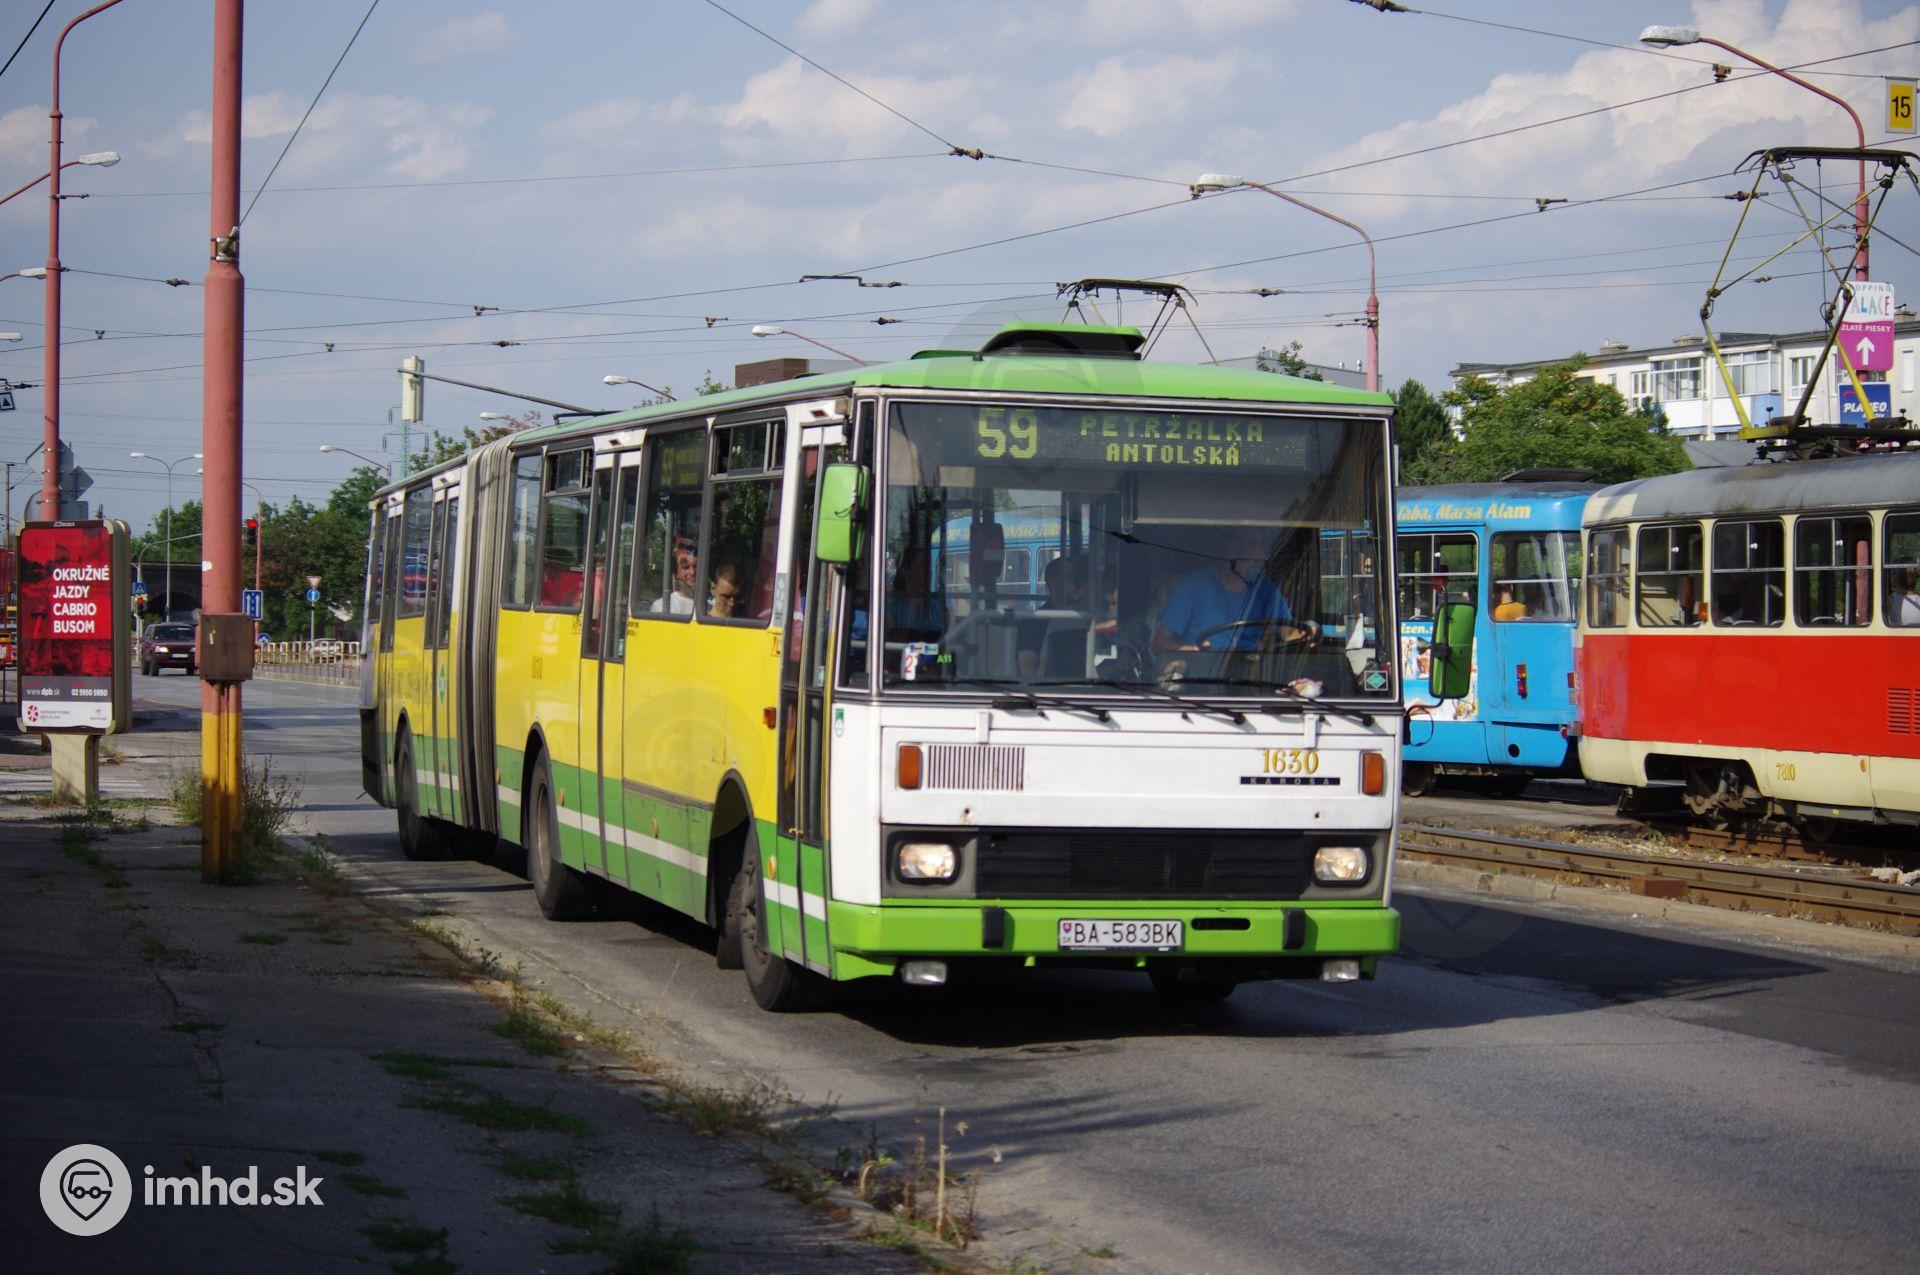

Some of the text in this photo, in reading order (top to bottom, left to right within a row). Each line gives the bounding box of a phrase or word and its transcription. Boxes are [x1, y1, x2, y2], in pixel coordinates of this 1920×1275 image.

[1891, 96, 1911, 118] 15
[1843, 295, 1890, 316] ALACE
[1843, 401, 1888, 413] PLAEO
[978, 407, 1038, 459] 59
[1080, 414, 1264, 442] PETRŽALKA
[1106, 441, 1240, 466] ANTOLSKÁ
[1435, 501, 1483, 520] Marsa
[1485, 501, 1531, 519] Alam
[52, 564, 110, 581] OKRUŽNÉ
[52, 585, 90, 599] JAZDY
[52, 602, 97, 616] CABRIO
[53, 620, 95, 633] BUSOM
[1263, 747, 1319, 775] 1630
[1074, 922, 1178, 944] BA-583BK
